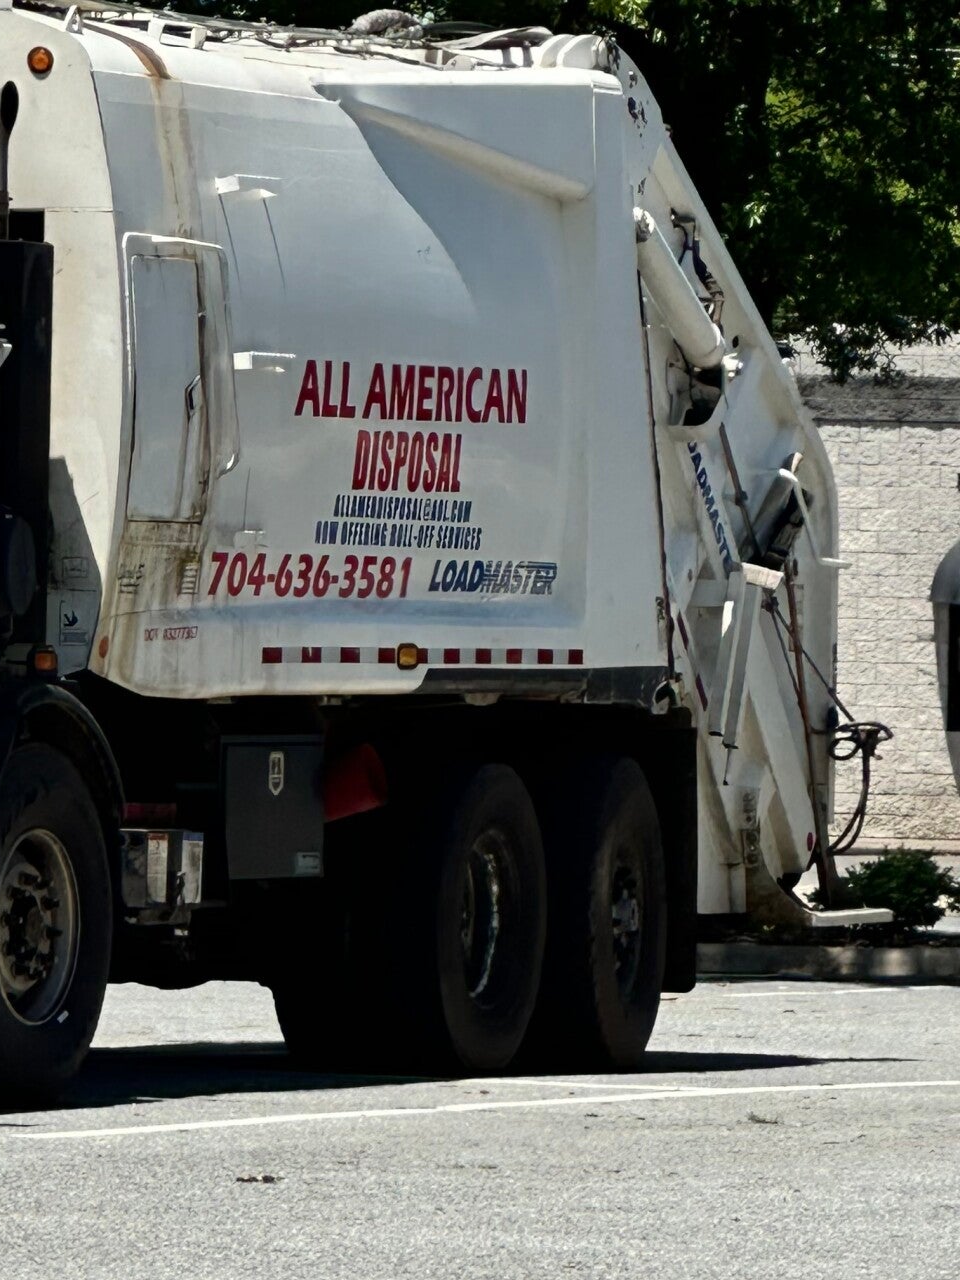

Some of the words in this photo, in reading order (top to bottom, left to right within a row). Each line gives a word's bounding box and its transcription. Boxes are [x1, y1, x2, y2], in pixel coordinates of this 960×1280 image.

[294, 360, 356, 418] ALL
[362, 363, 528, 424] AMERICAN
[351, 430, 462, 493] DISPOSAL
[315, 521, 339, 544] NOW
[341, 521, 388, 547] OFFERING
[389, 524, 435, 549] ROLL-OFF
[436, 525, 483, 550] SERVICES
[208, 552, 413, 598] 704-636-3581
[428, 559, 557, 595] LOADMASTER
